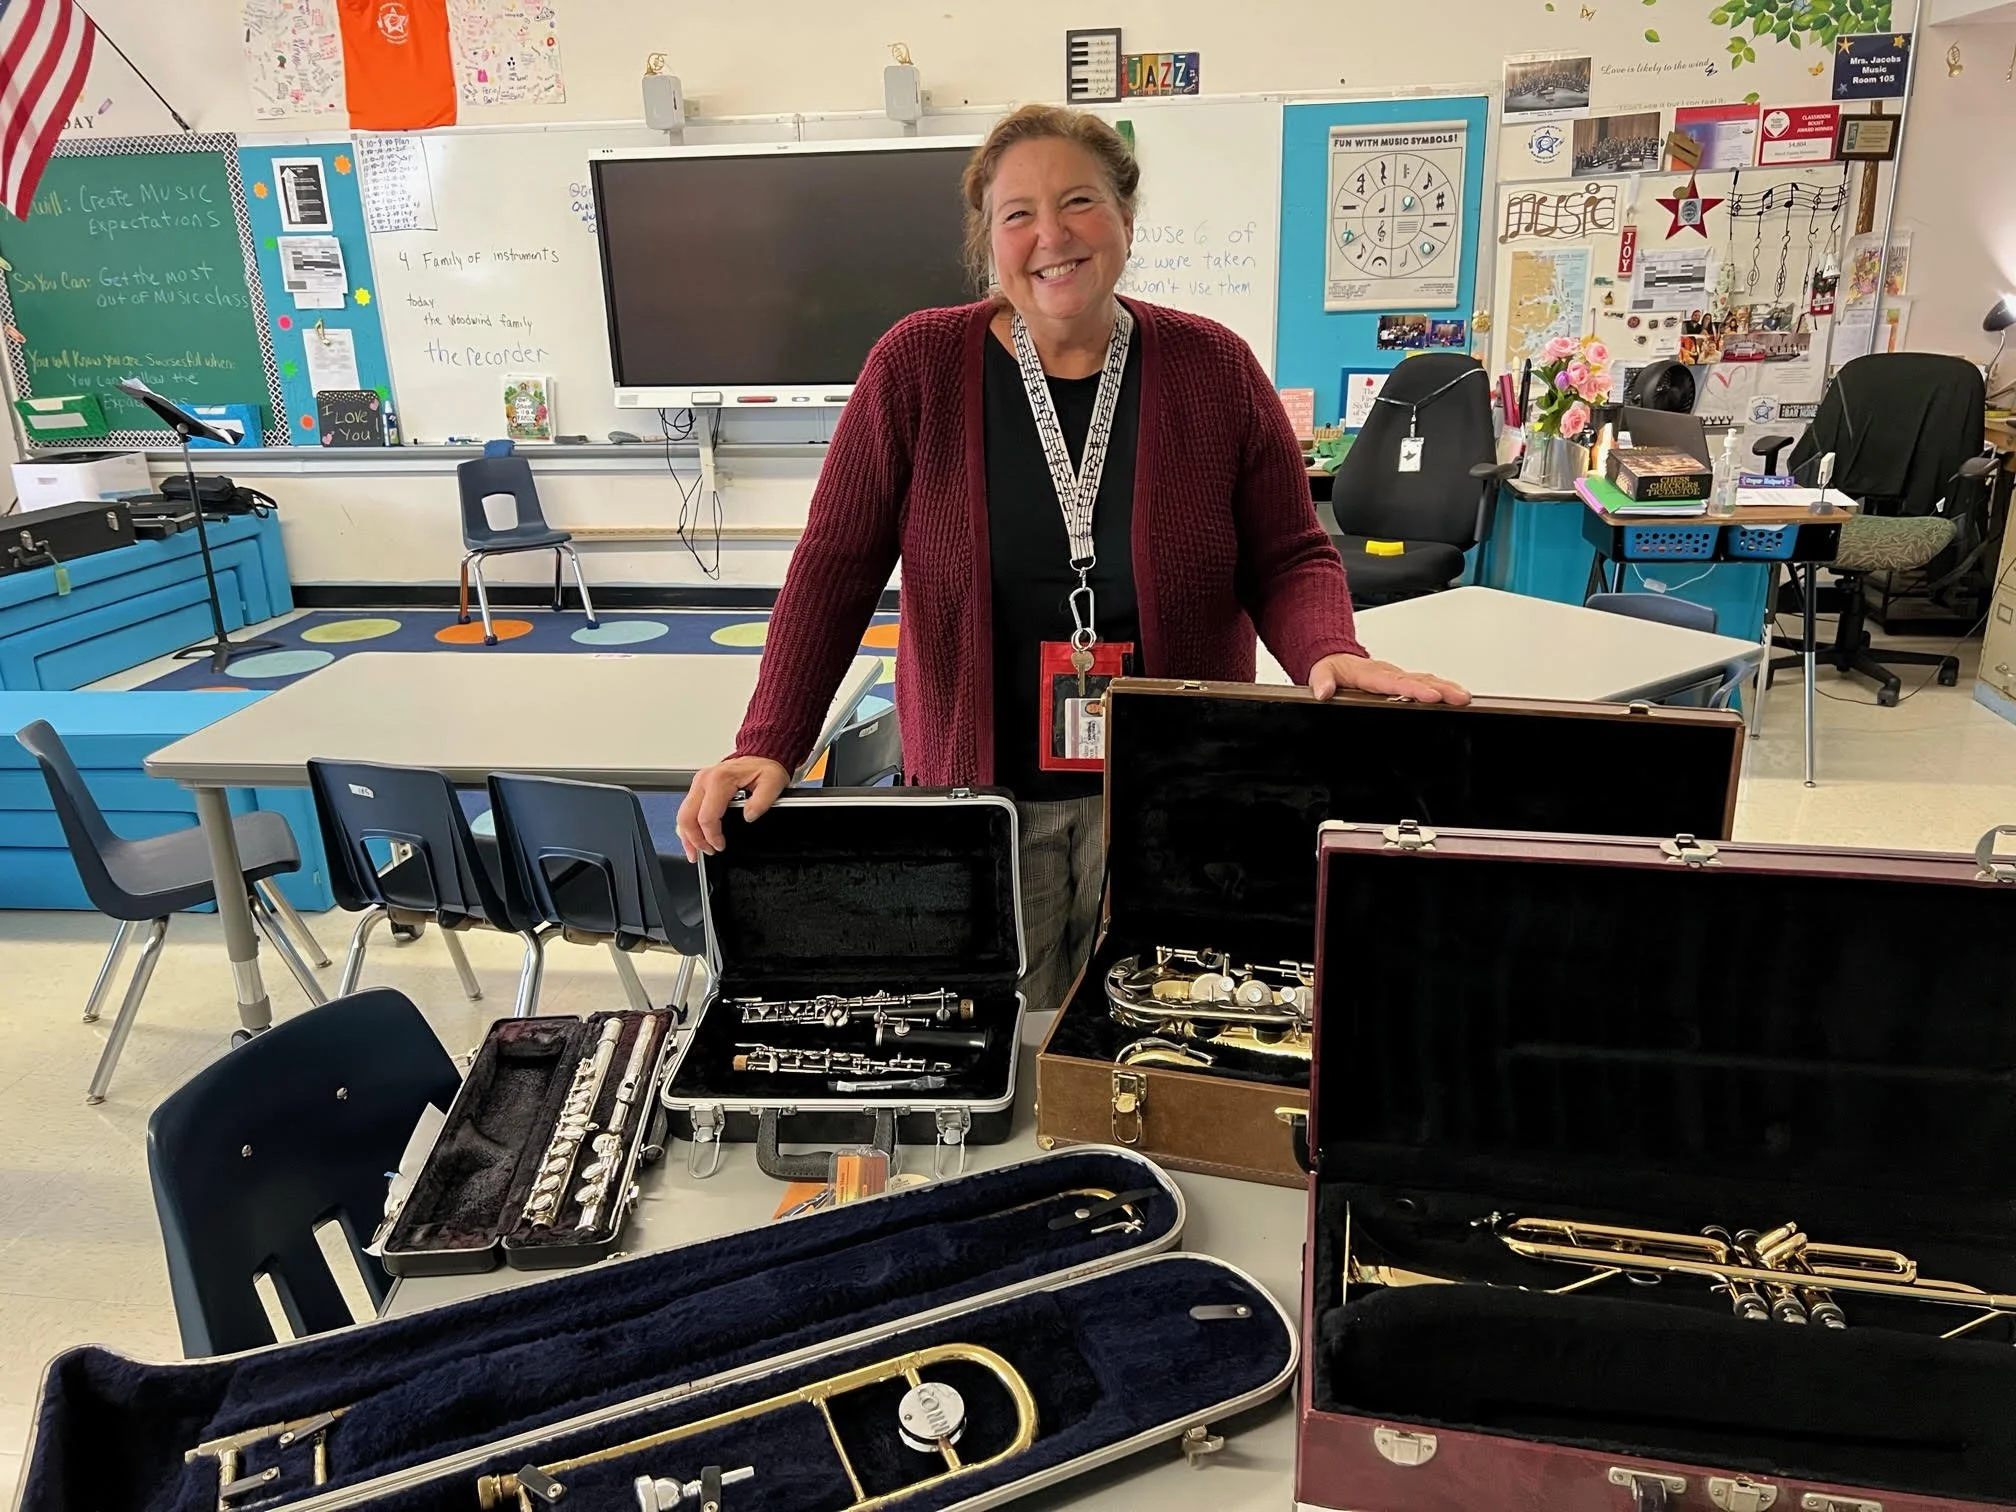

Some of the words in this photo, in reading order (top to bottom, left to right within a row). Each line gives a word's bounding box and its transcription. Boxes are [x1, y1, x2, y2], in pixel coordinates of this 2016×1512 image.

[1600, 64, 1625, 75] Love
[1627, 64, 1635, 73] is
[1637, 62, 1661, 74] likely
[1663, 63, 1672, 71] to
[1673, 60, 1686, 70] the
[1688, 58, 1709, 68] wind
[1850, 56, 1868, 65] Mrs.
[1870, 55, 1902, 64] Jacobs
[1862, 66, 1887, 75] Music
[1129, 61, 1187, 90] JAZZ
[1853, 76, 1877, 84] Room
[1879, 75, 1895, 83] 105
[1334, 139, 1352, 148] FUN
[1355, 138, 1379, 147] WITH
[1381, 137, 1410, 146] MUSIC
[1411, 134, 1458, 145] SYMBOLS!
[80, 184, 134, 212] Create
[89, 210, 221, 241] Expectations
[1136, 225, 1185, 245] ause
[1228, 221, 1257, 243] of
[399, 251, 410, 271] 4
[422, 250, 463, 271] Family
[493, 247, 560, 264] instruments
[1154, 255, 1192, 271] were
[1203, 250, 1256, 269] taken
[1621, 231, 1633, 272] JOY
[132, 264, 160, 286] the
[1132, 277, 1179, 294] won't
[205, 285, 250, 309] class
[406, 292, 436, 309] today
[424, 312, 442, 326] the
[500, 313, 533, 335] family
[424, 338, 461, 367] the
[466, 341, 549, 367] recorder
[171, 371, 200, 386] the
[322, 403, 333, 416] I
[1785, 408, 1799, 418] BAR
[1649, 481, 1699, 490] CHECKERS
[917, 1387, 950, 1434] CONN
